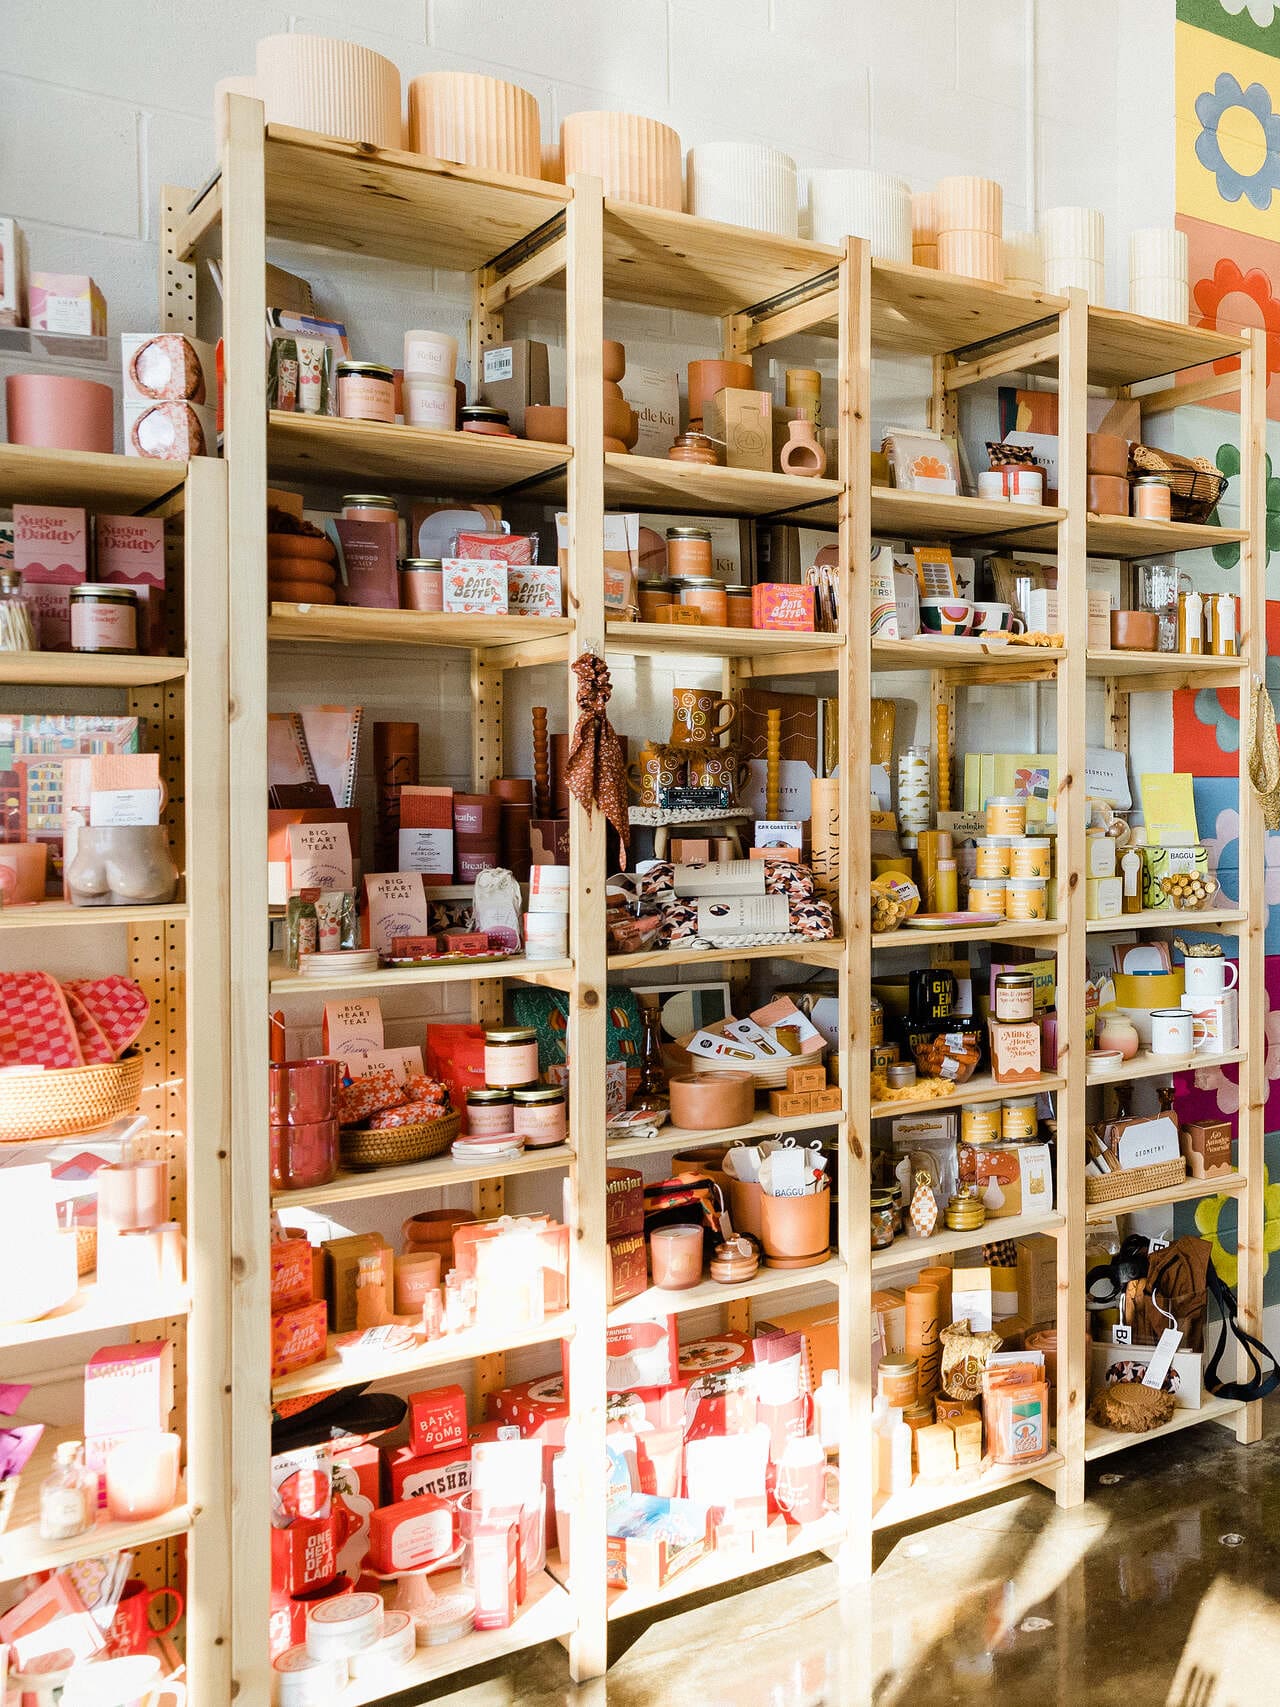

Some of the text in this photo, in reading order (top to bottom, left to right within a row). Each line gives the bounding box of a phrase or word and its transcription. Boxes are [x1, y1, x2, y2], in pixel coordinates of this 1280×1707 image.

[659, 412, 675, 426] Kit
[17, 513, 67, 531] Sugar
[16, 528, 81, 545] Daddy
[101, 524, 148, 540] Sugar
[101, 536, 160, 554] Daddy
[716, 559, 735, 572] Kit
[465, 577, 492, 589] DATE
[520, 583, 547, 594] DATE
[454, 585, 497, 599] BETTER
[511, 591, 552, 604] BETTER
[781, 599, 802, 610] DATE
[771, 608, 807, 619] BETTER
[953, 822, 985, 832] Ecologie
[301, 836, 337, 844] HEART
[307, 843, 334, 851] TEAS
[1170, 852, 1194, 860] BAGGU
[461, 861, 492, 870] Breathe
[378, 885, 412, 893] HEART
[933, 981, 951, 993] GIV
[1034, 974, 1053, 987] TCHA
[337, 1011, 370, 1019] HEART
[1001, 1030, 1025, 1041] Milk
[1009, 1038, 1037, 1047] Honey
[368, 1062, 386, 1070] BIG
[1211, 1131, 1222, 1139] Go
[1206, 1137, 1230, 1148] Smudge
[1135, 1145, 1166, 1158] GEOMETRY
[606, 1176, 641, 1194] Milkjar
[775, 1188, 804, 1197] BAGGU
[612, 1236, 645, 1258] Milkjar
[276, 1264, 300, 1282] DATE
[406, 1280, 431, 1291] Vibes
[293, 1324, 316, 1342] DATE
[282, 1333, 320, 1356] BETTER
[420, 1410, 455, 1431] BATH
[425, 1426, 463, 1443] BOMB
[411, 1471, 472, 1498] MUSHR
[307, 1530, 331, 1547] ONE
[305, 1542, 333, 1560] HELL
[306, 1557, 324, 1571] OF
[303, 1564, 334, 1584] LADY
